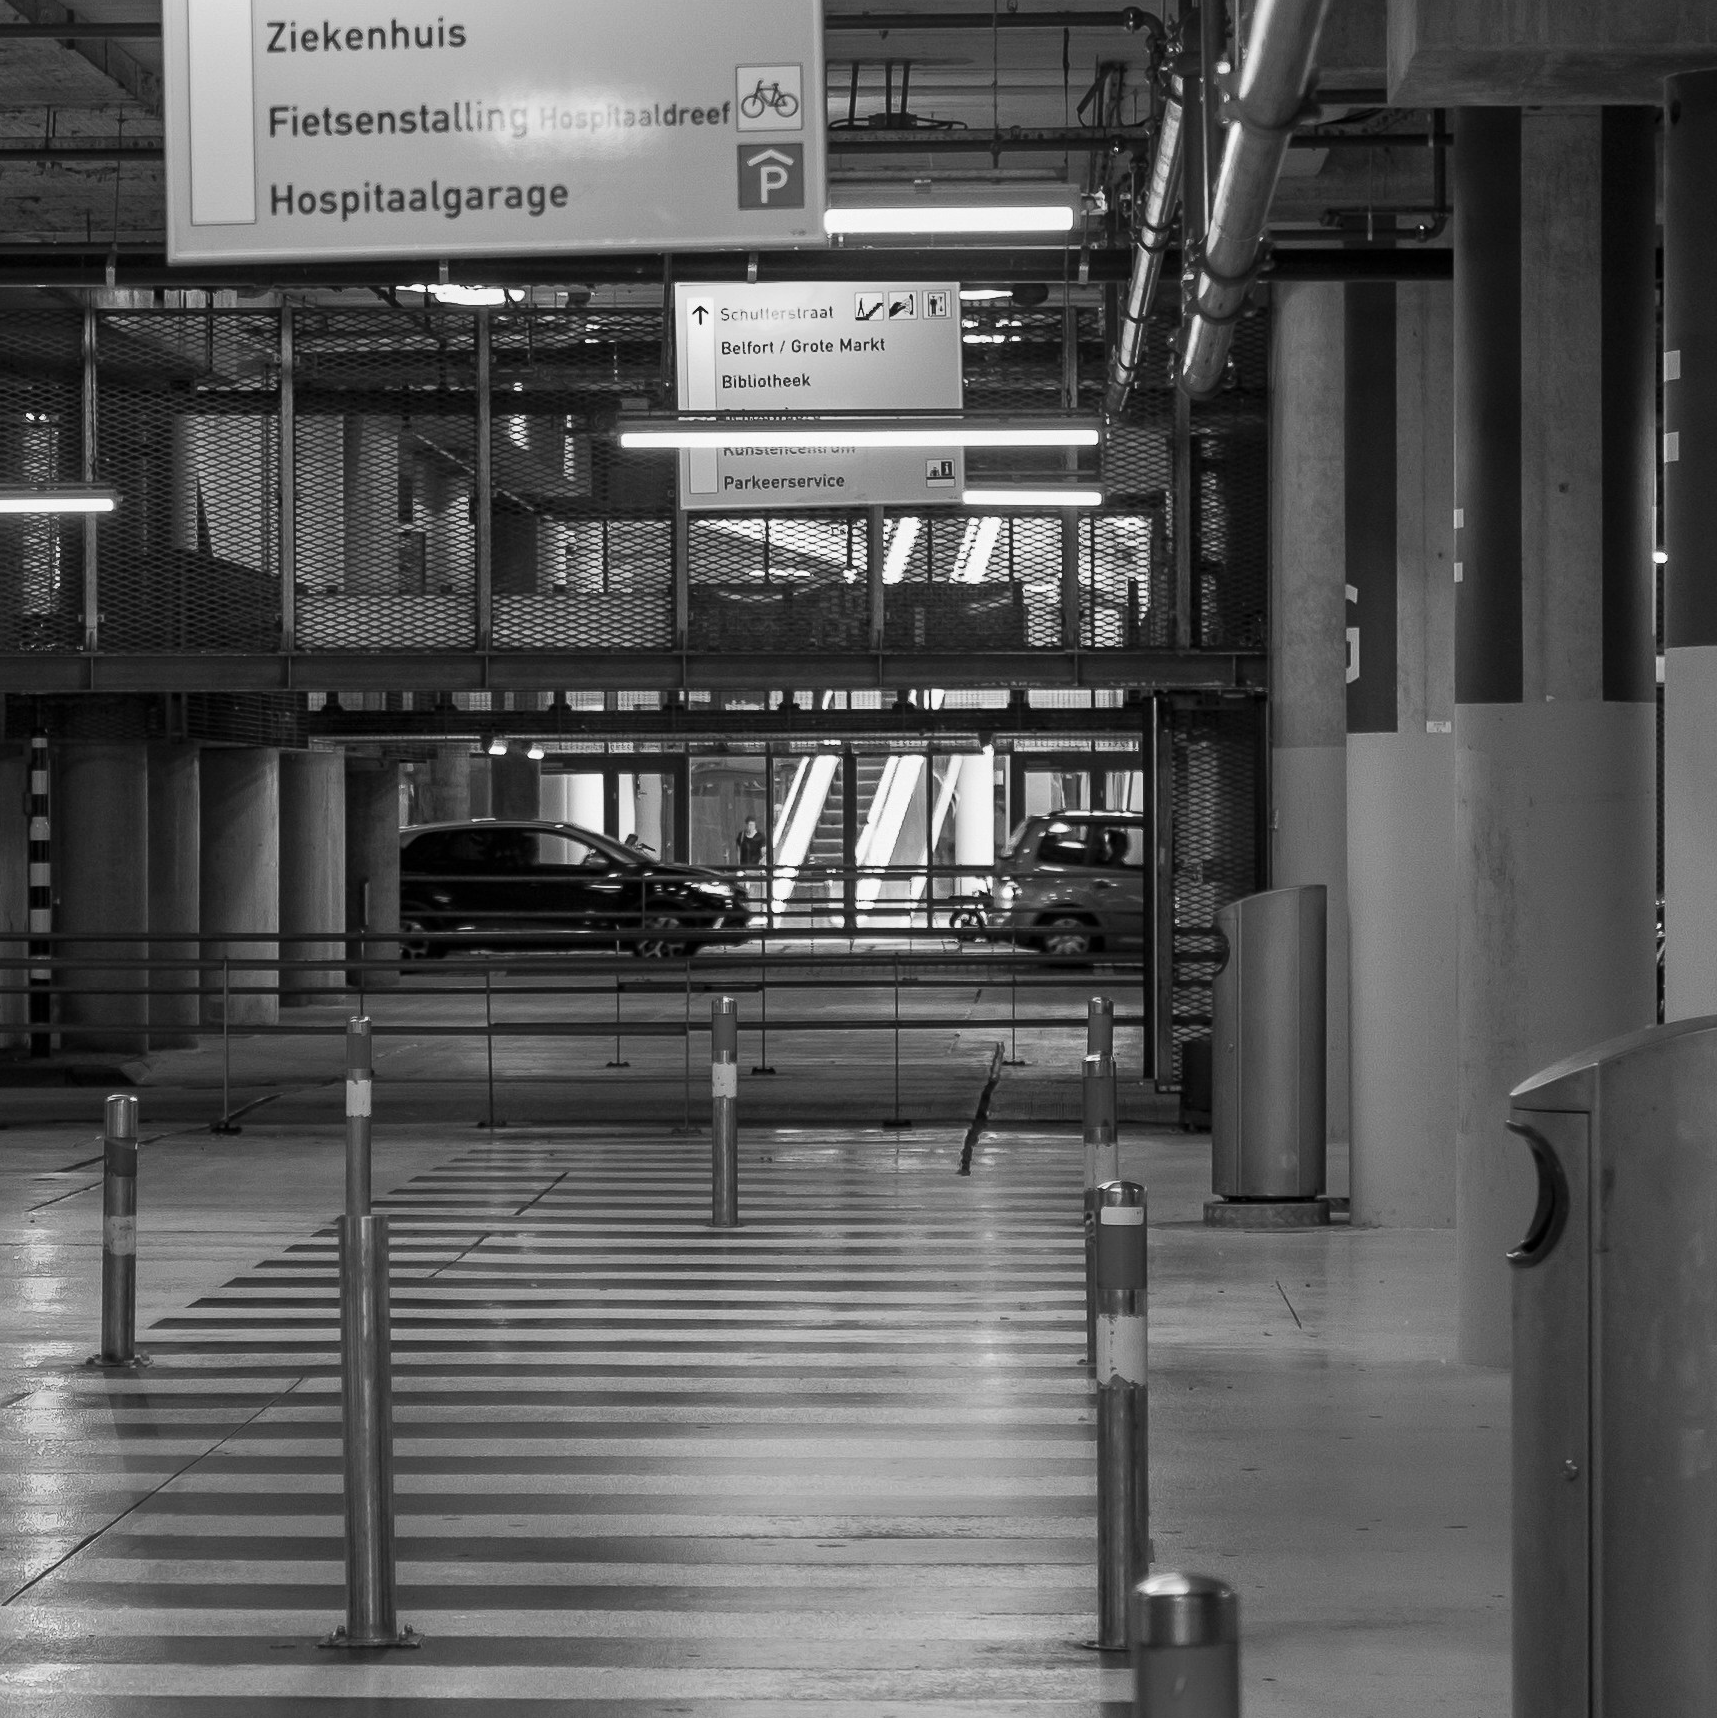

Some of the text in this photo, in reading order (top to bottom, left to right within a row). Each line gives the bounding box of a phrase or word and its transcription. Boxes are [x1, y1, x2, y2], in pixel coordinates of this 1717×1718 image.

[266, 16, 467, 53] Ziekenhuis
[269, 101, 732, 139] Fietsenstalling Hospitaaldreef
[270, 179, 569, 222] Hospitaalgarage
[721, 340, 774, 355] Belfort
[791, 338, 834, 353] Grote
[839, 337, 886, 353] Markt
[722, 373, 812, 389] Bibliotheek
[724, 474, 846, 491] Parkeerservice
